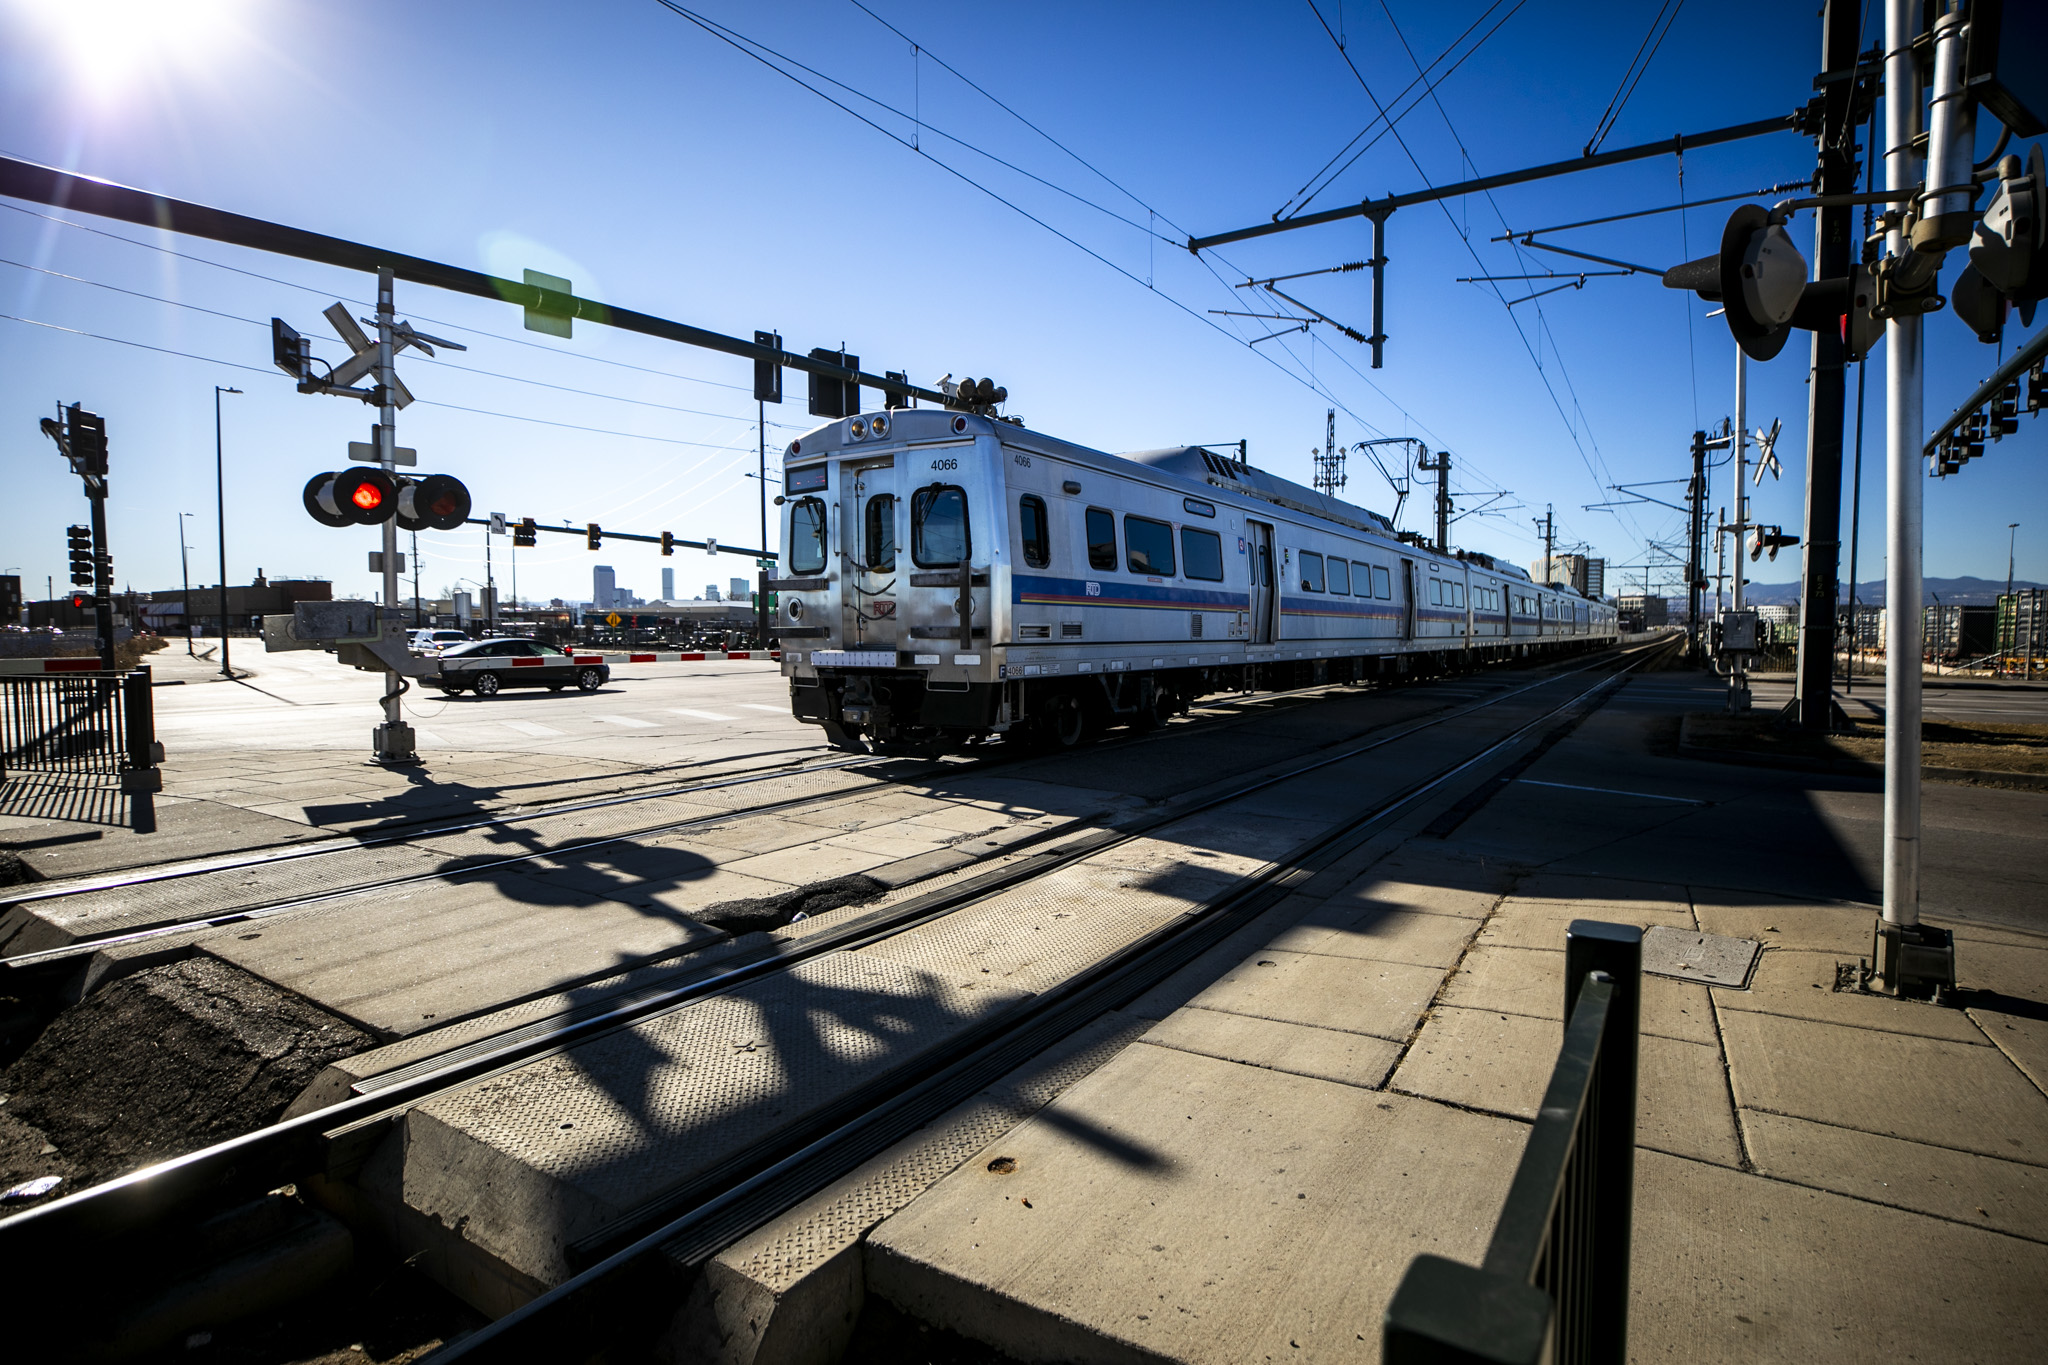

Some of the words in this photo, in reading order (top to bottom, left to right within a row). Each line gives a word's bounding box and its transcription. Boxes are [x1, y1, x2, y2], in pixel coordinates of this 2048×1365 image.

[930, 459, 958, 471] 4066
[1014, 455, 1031, 468] 4066
[1086, 581, 1101, 596] RTD
[873, 601, 896, 616] RTD
[1000, 666, 1006, 677] F
[1007, 666, 1023, 676] 4066
